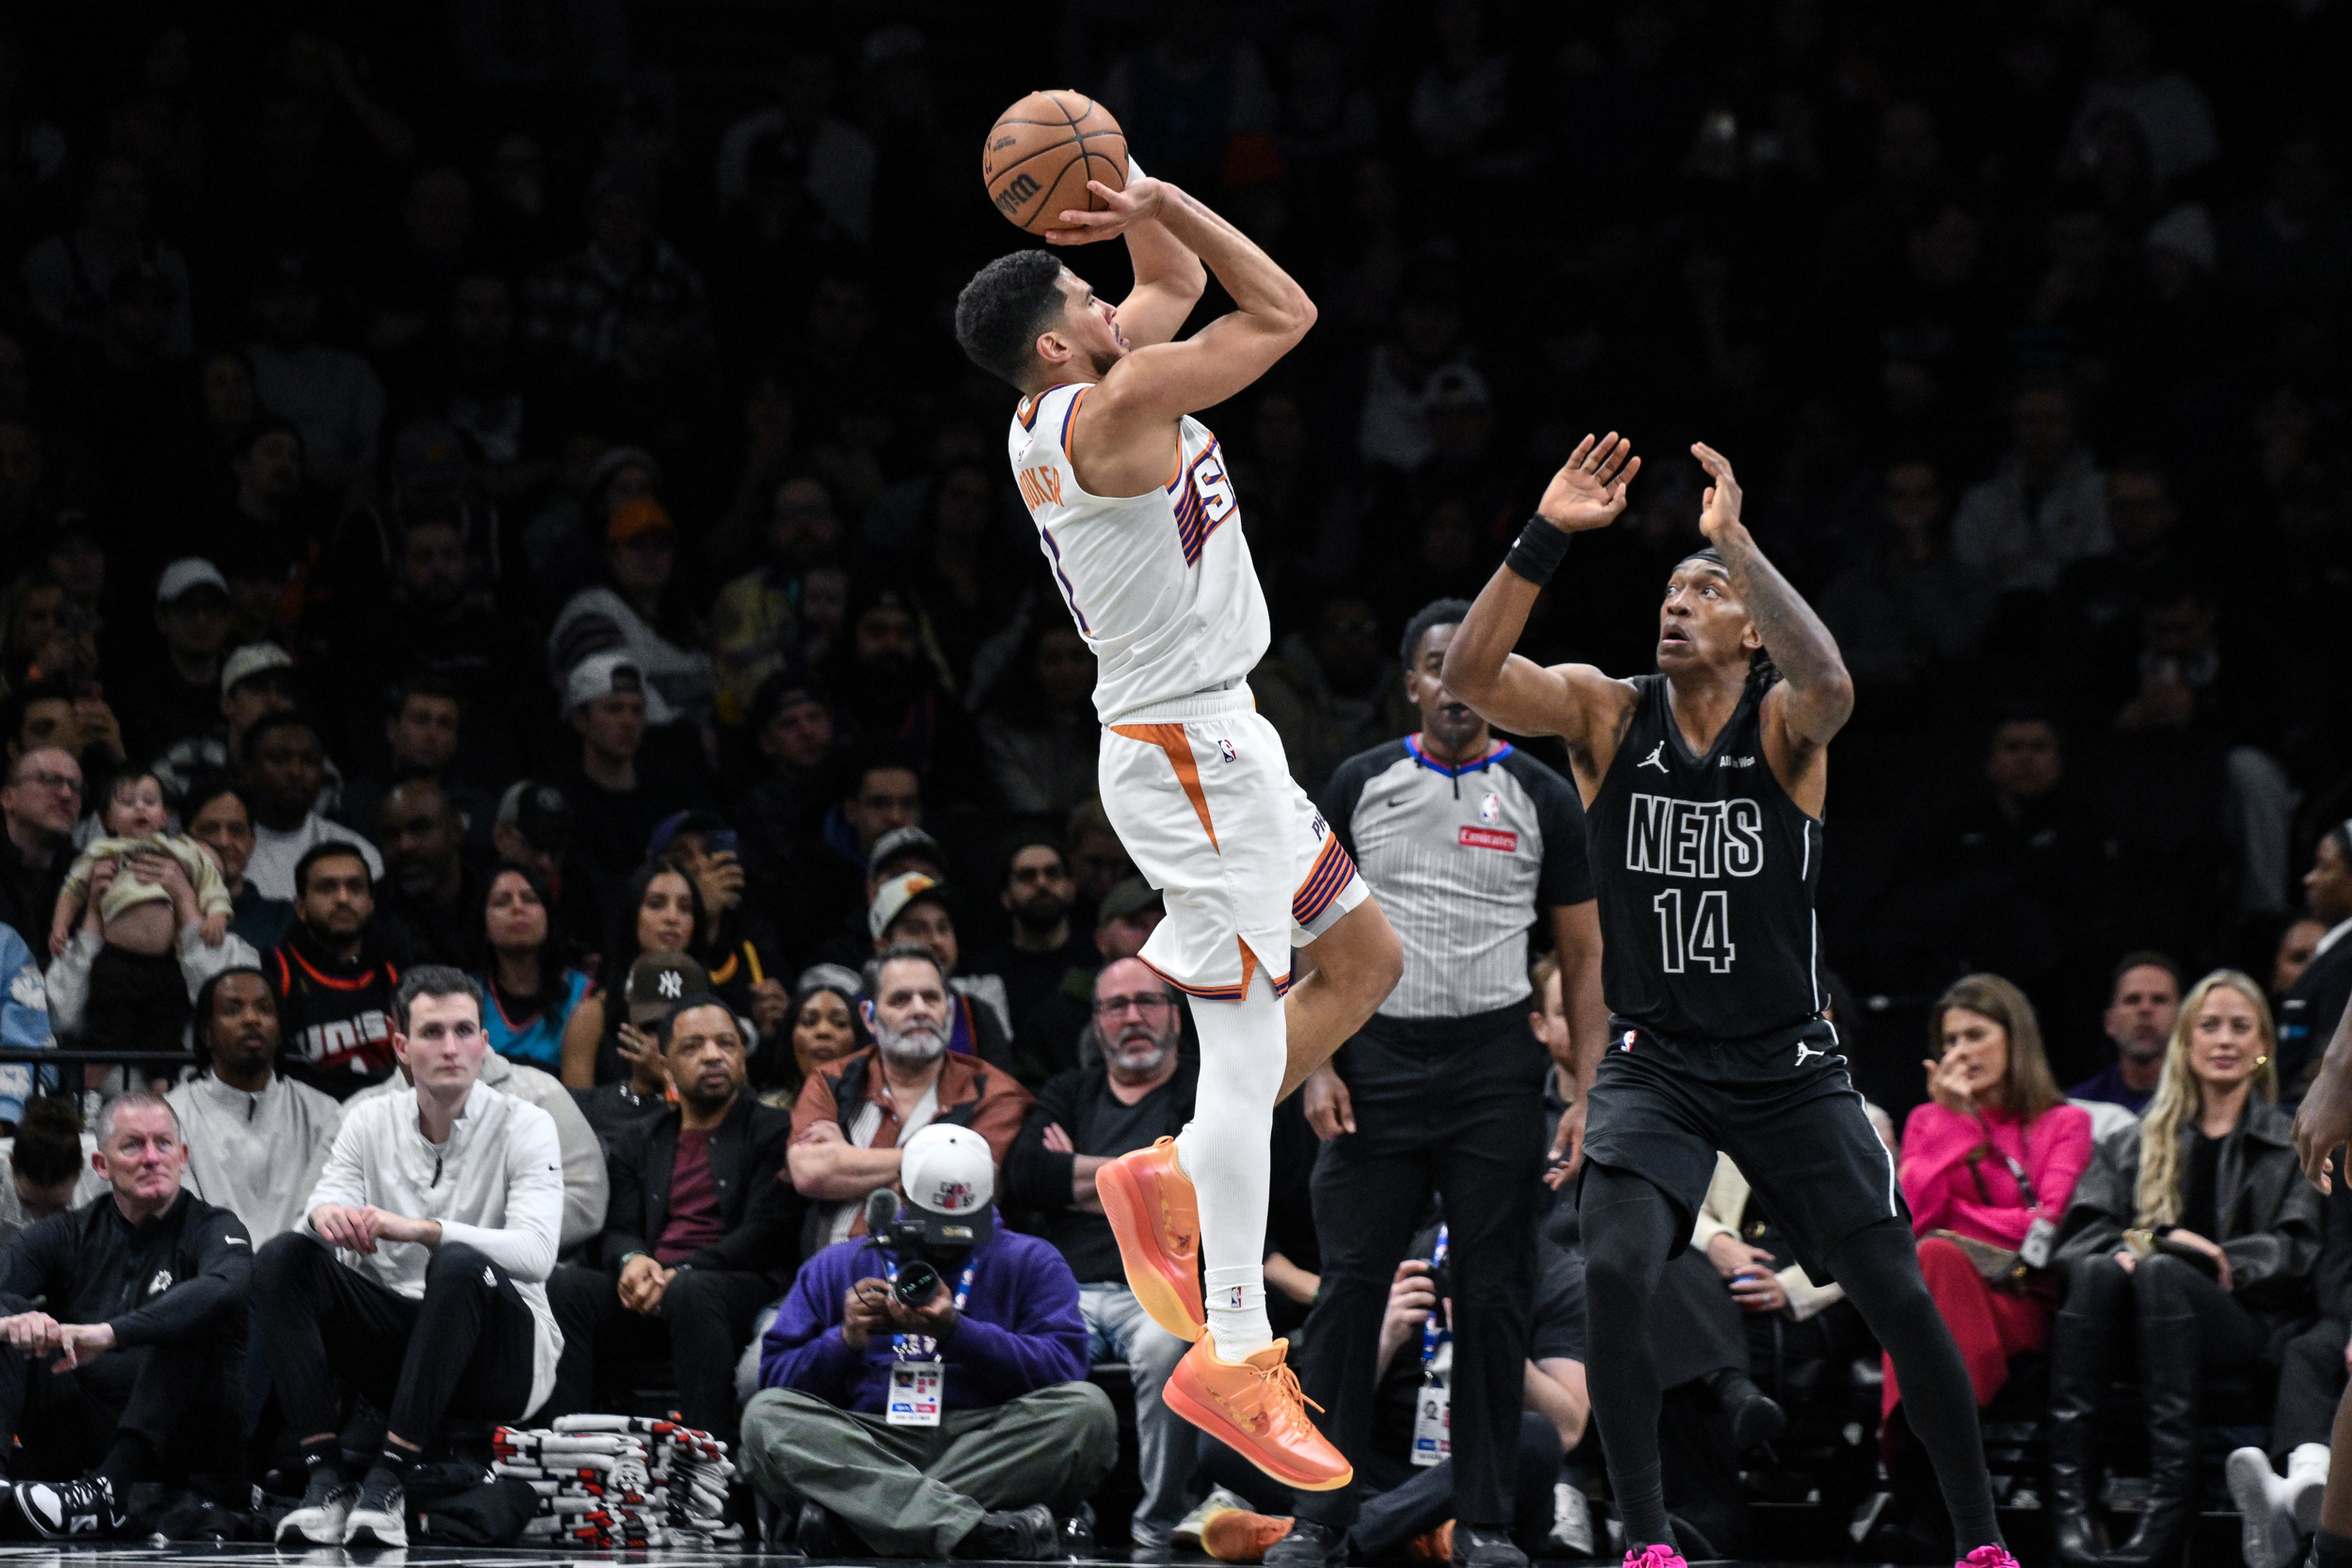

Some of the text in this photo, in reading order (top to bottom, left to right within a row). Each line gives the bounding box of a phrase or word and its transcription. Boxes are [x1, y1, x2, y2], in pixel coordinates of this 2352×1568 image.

[1720, 755, 1731, 768] All
[1627, 792, 1764, 879] NETS
[1653, 888, 1736, 974] 14
